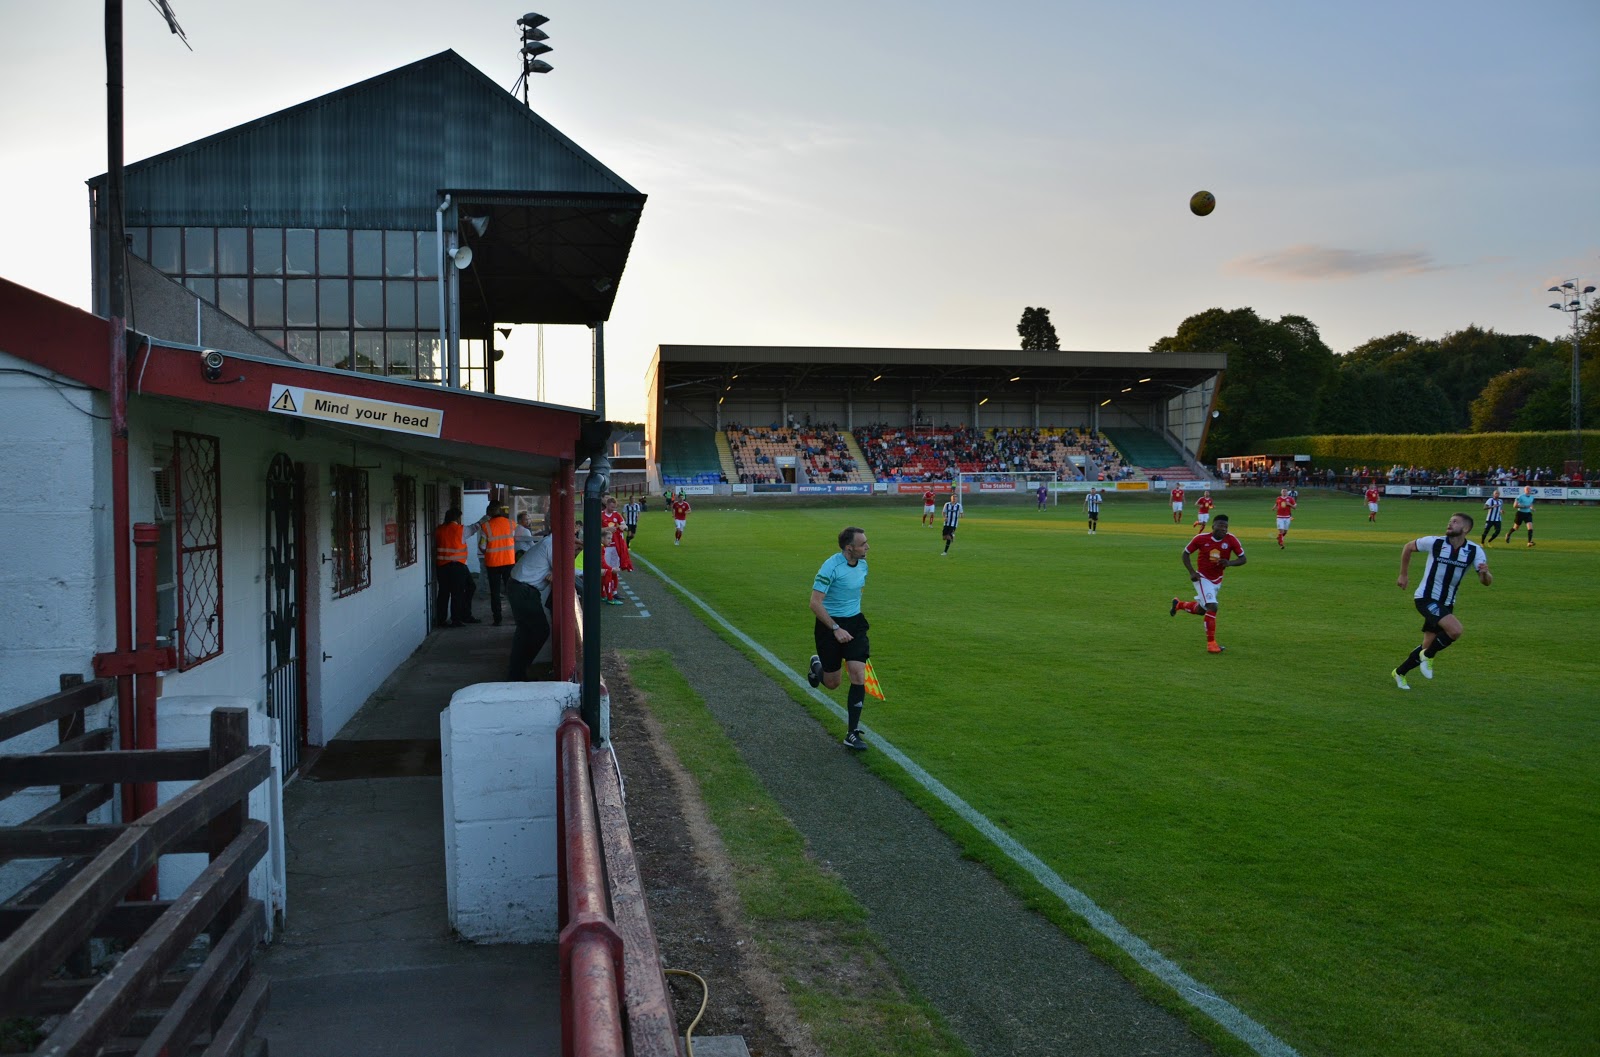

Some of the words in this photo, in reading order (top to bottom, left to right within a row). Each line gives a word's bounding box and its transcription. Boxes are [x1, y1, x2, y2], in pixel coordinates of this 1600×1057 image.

[314, 399, 349, 416] Mind
[355, 408, 388, 420] your
[393, 411, 429, 428] head
